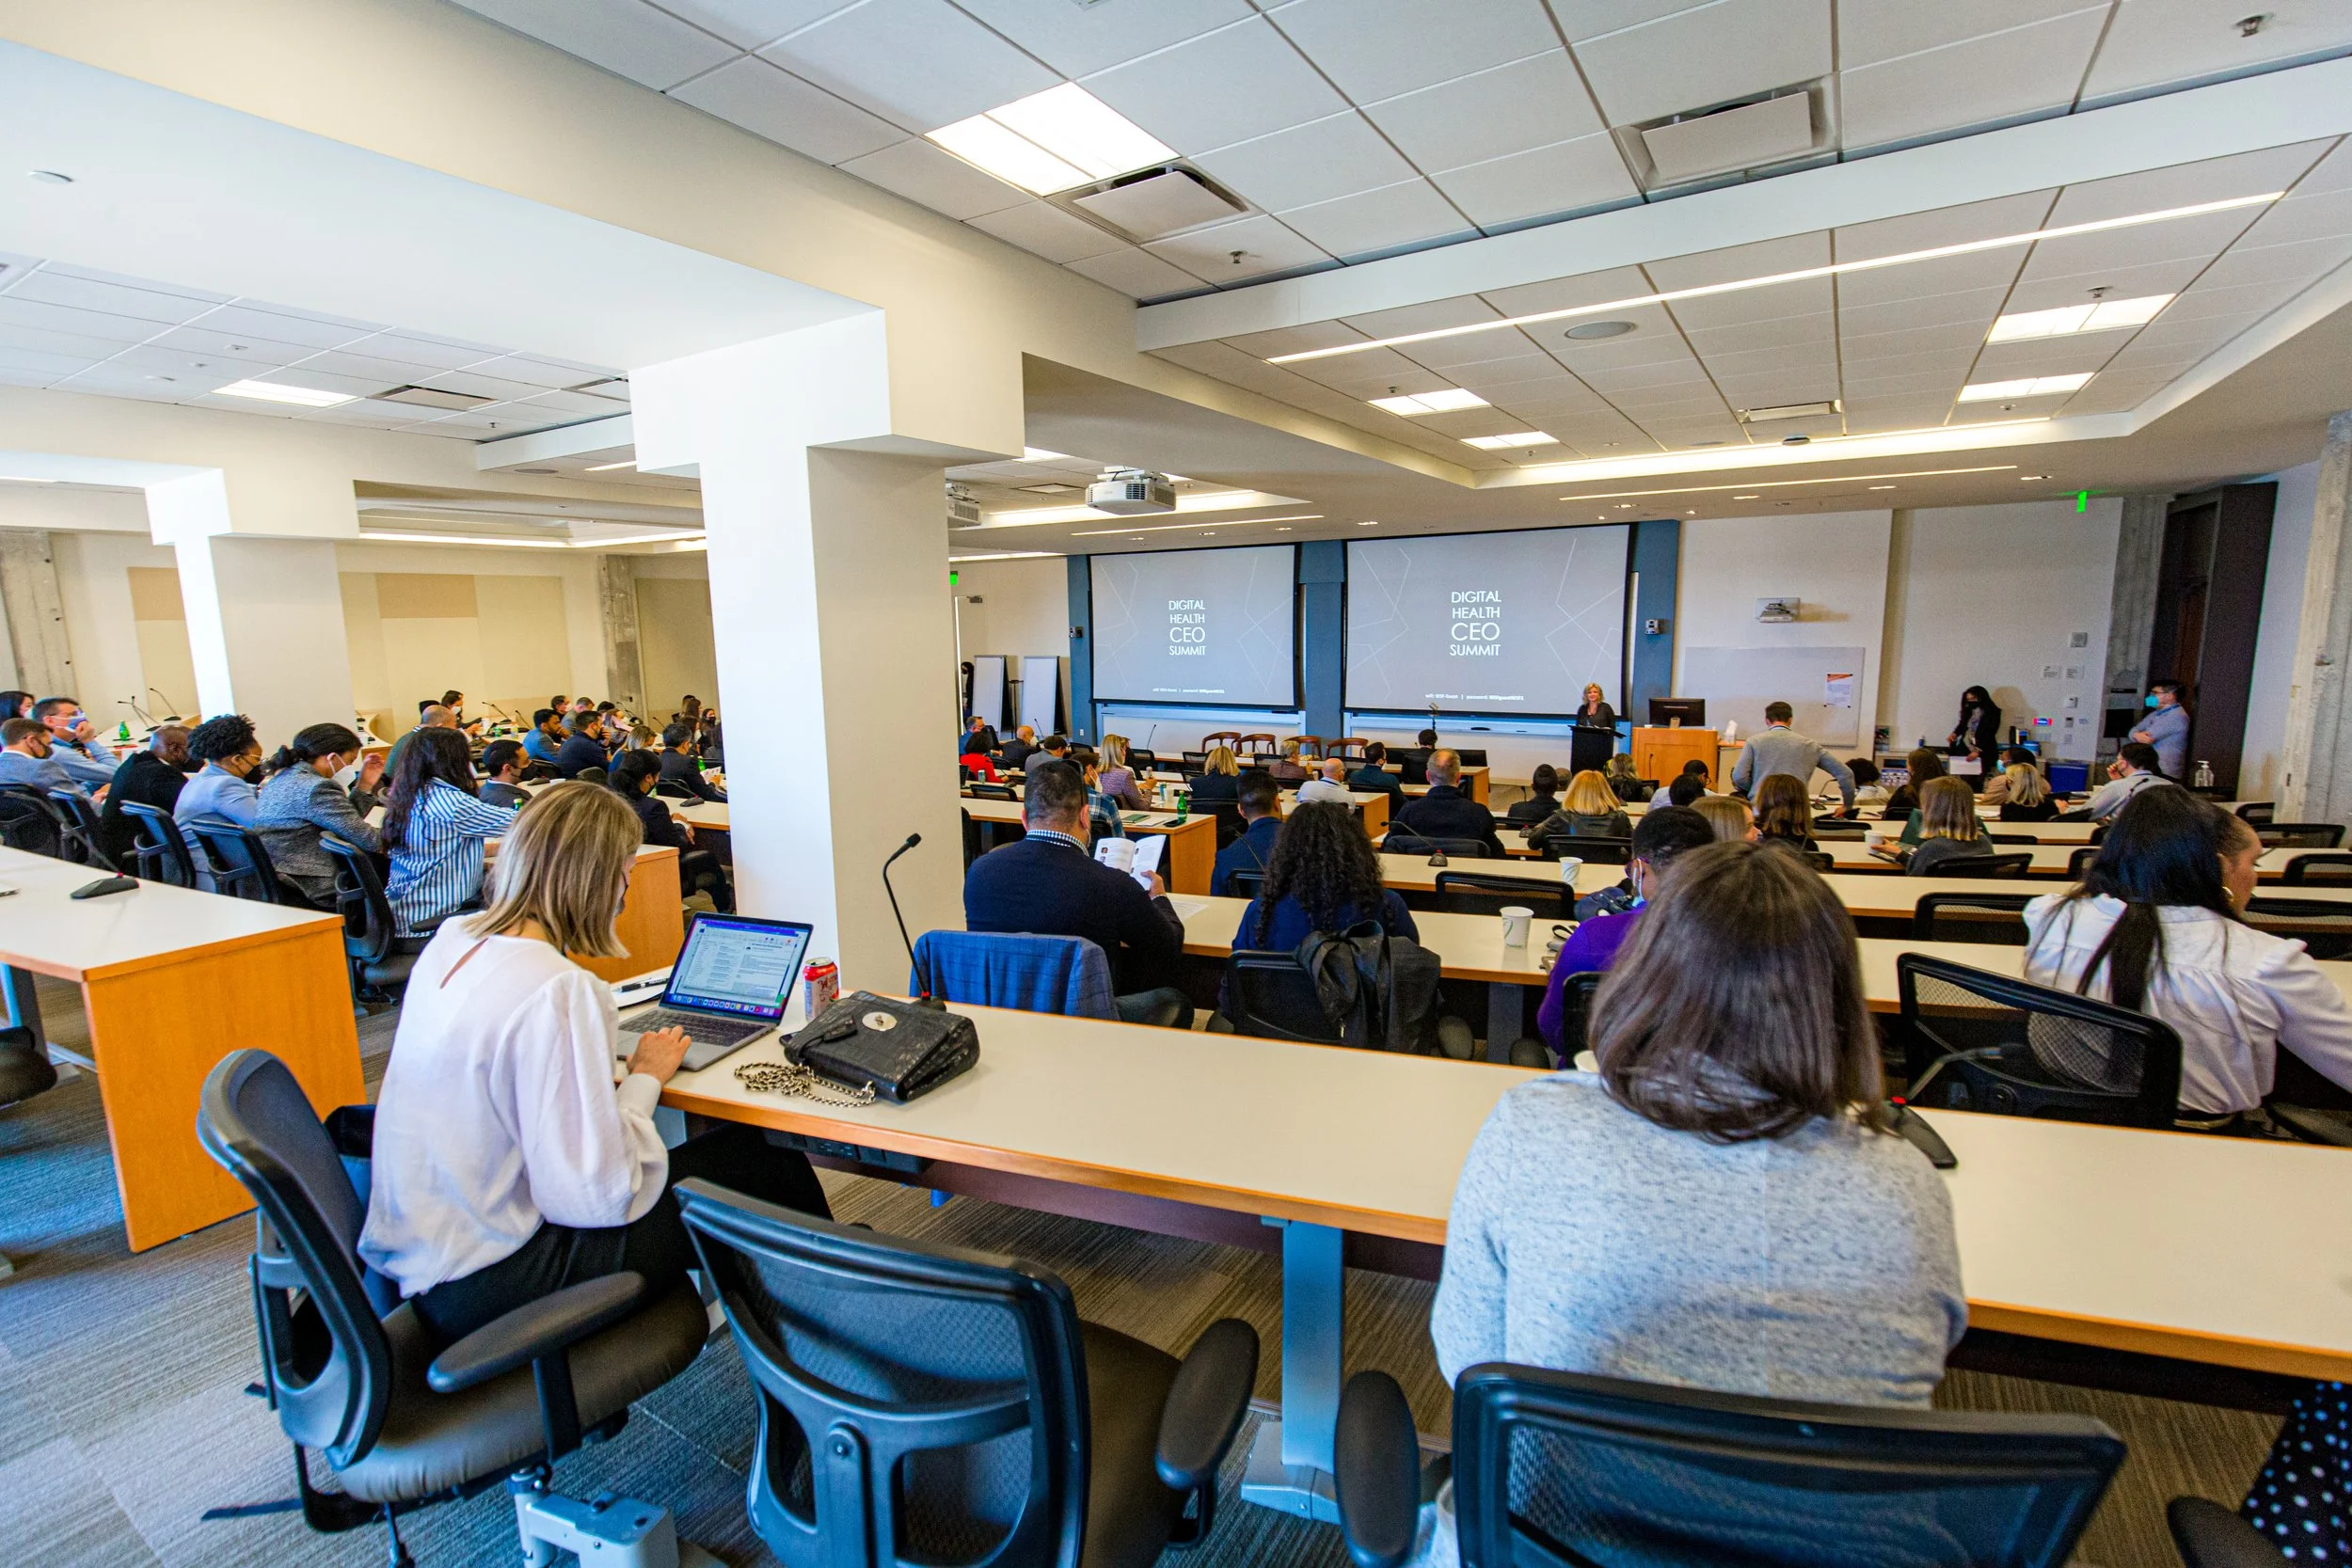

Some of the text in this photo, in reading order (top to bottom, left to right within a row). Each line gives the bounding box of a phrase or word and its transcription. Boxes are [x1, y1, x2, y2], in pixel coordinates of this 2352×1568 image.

[1451, 590, 1502, 603] DIGITAL
[1168, 599, 1206, 610] DIGITAL
[1169, 613, 1205, 624] HEALTH
[1452, 606, 1501, 619] HEALTH
[1169, 626, 1206, 642] CEO
[1451, 622, 1501, 641] CEO
[1168, 645, 1207, 656] SUMMIT
[1449, 643, 1502, 657] SUMMIT
